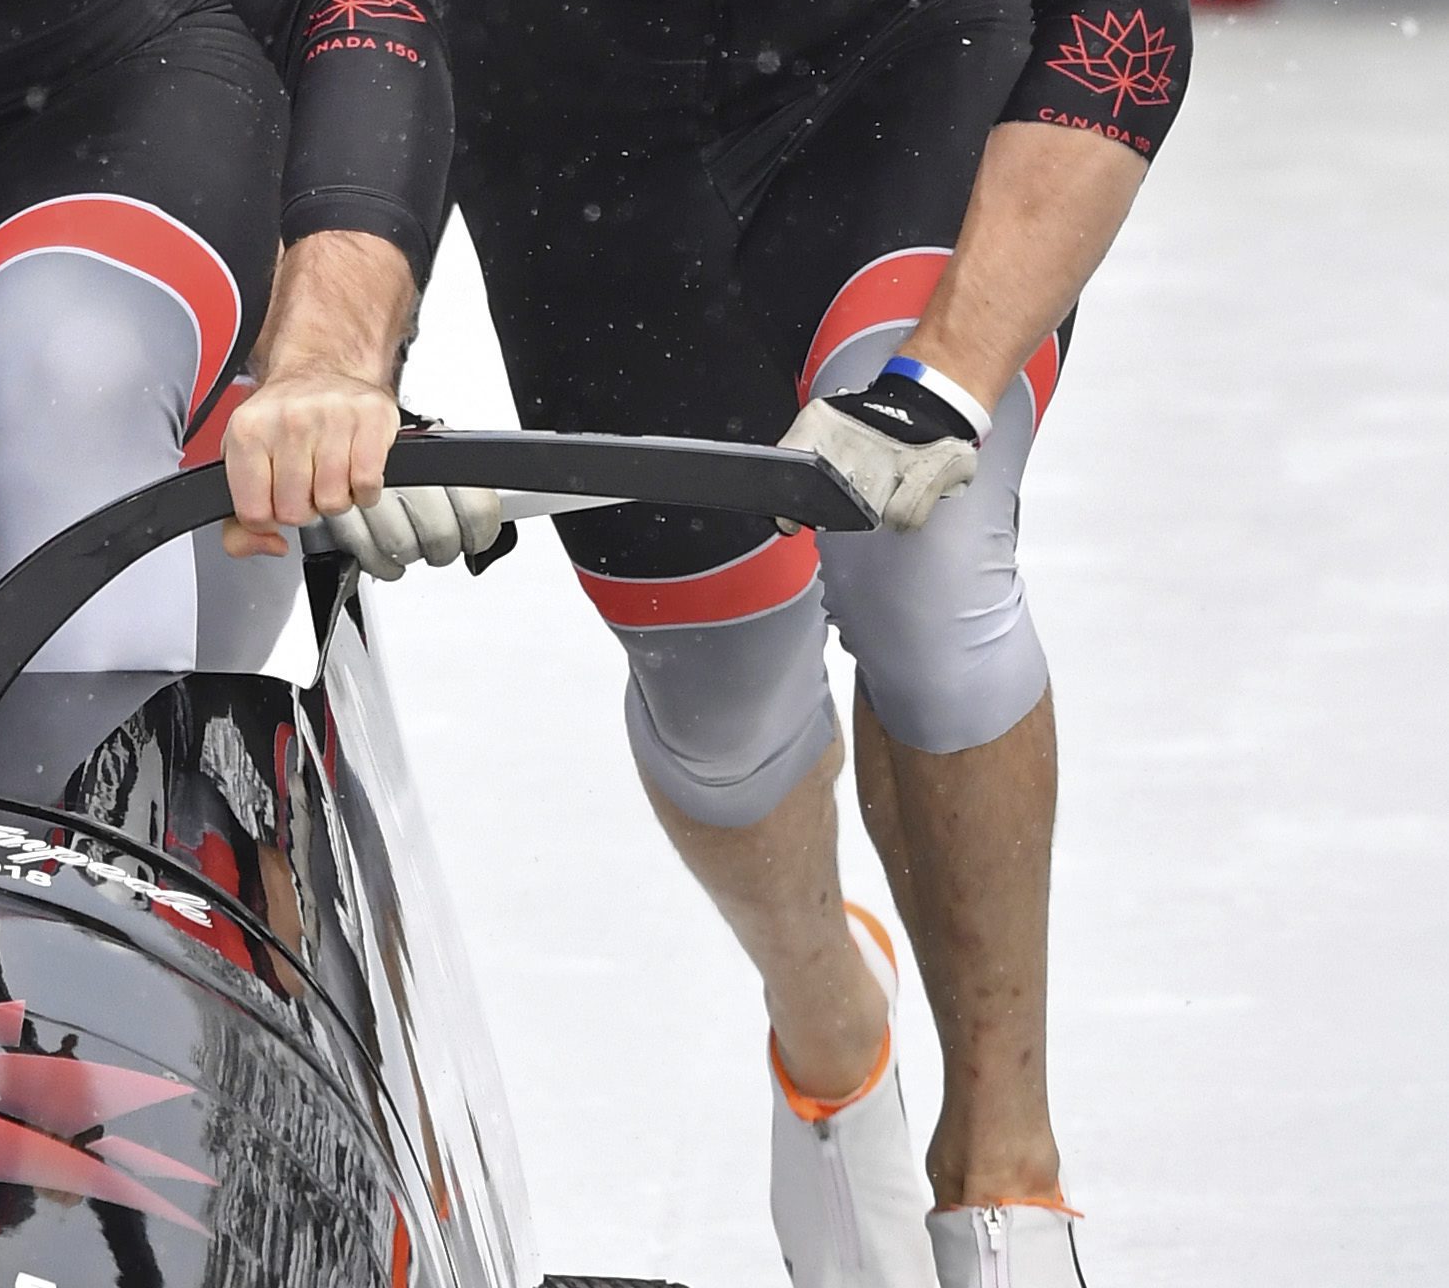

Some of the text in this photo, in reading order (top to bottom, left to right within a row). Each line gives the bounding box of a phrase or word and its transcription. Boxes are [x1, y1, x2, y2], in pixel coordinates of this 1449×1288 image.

[306, 37, 418, 63] ANADA 150
[1038, 108, 1131, 143] CANADA
